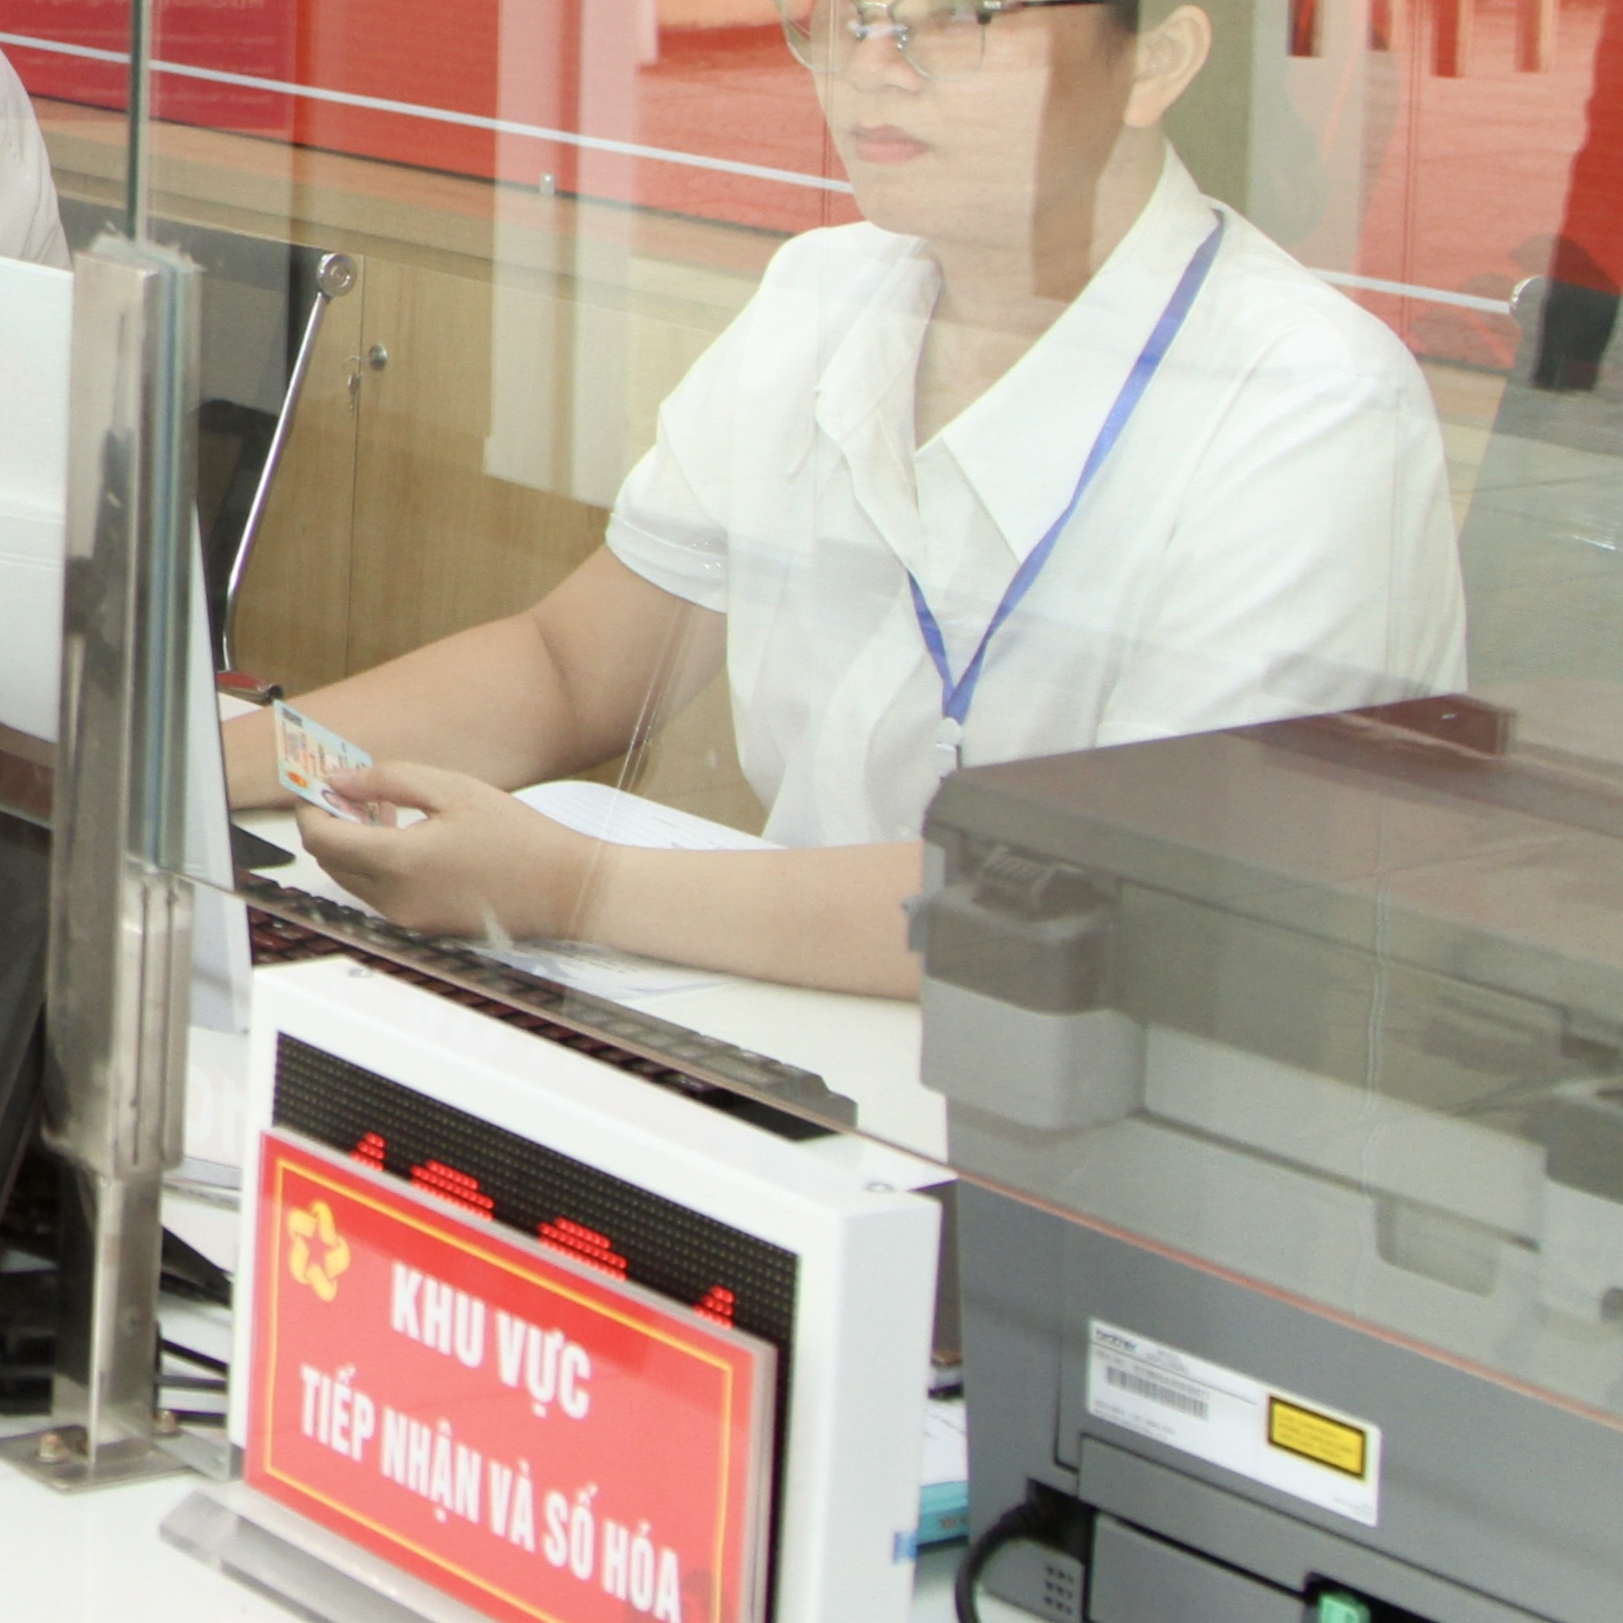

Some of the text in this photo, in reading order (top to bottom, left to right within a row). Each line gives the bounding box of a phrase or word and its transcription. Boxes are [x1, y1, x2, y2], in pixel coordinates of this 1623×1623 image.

[390, 1261, 592, 1420] KHU VỰC
[301, 1364, 682, 1623] TIẾP NHẬN VÀ SỐ HÓA
